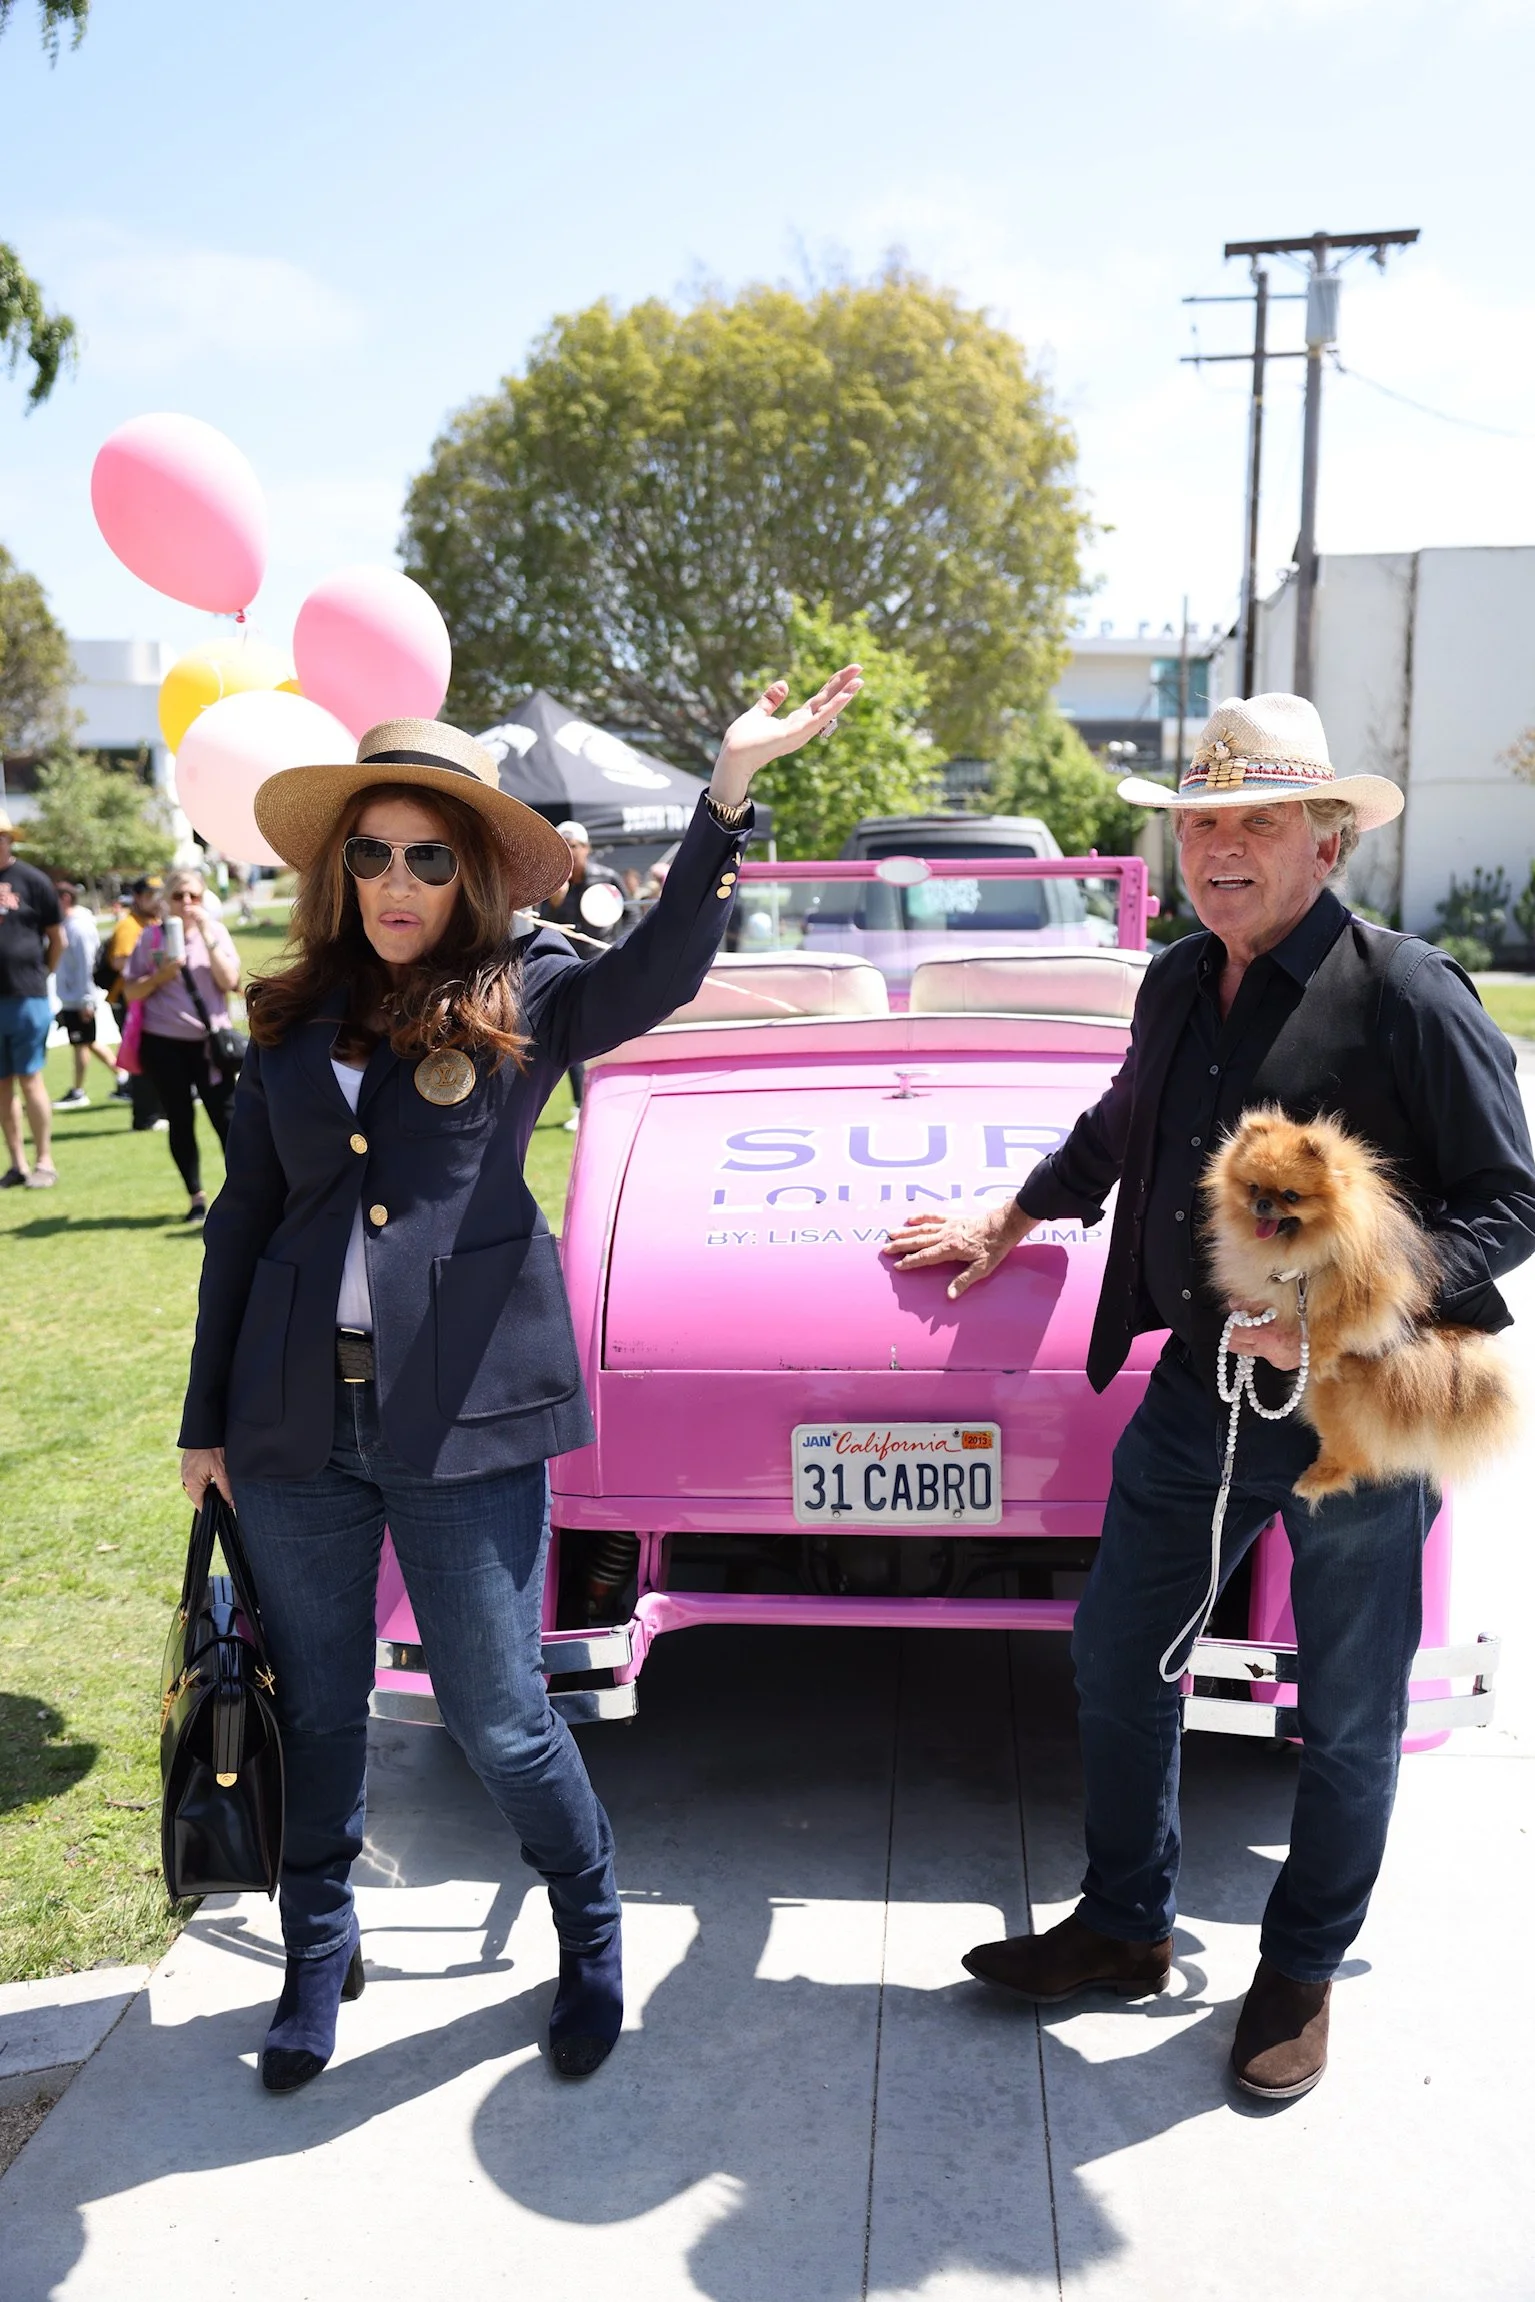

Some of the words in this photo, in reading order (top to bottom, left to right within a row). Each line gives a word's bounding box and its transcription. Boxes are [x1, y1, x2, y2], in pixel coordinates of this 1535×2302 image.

[720, 1124, 1074, 1171] SUR
[707, 1231, 757, 1245] BY:
[769, 1229, 844, 1243] LISA
[802, 1435, 831, 1448] JAN
[836, 1431, 961, 1461] California
[967, 1435, 988, 1445] 2013
[804, 1463, 853, 1511] 31
[864, 1462, 992, 1511] CABRO
